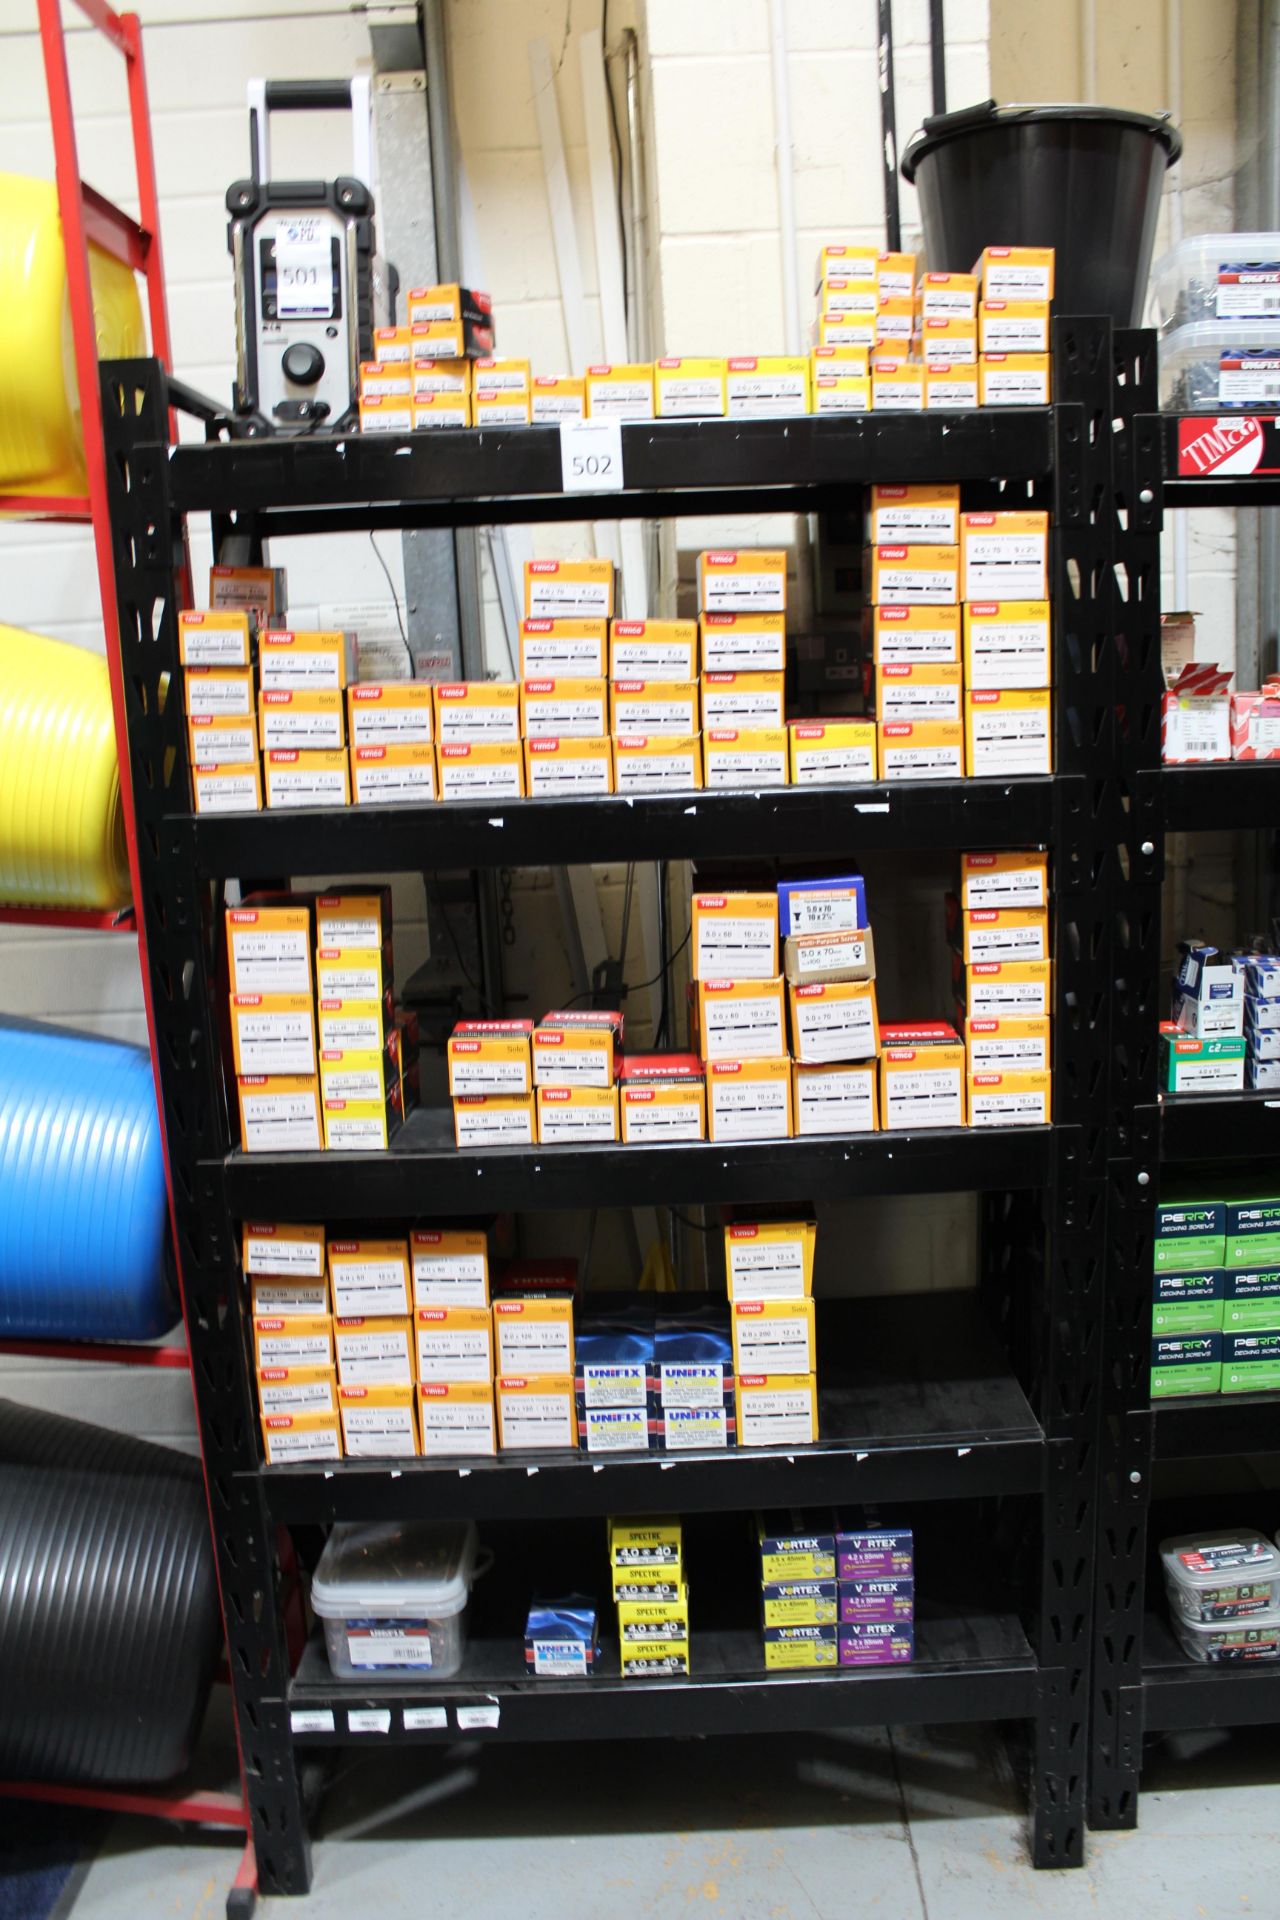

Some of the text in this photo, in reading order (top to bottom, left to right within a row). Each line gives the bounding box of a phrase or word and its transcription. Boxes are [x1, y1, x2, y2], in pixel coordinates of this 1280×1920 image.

[283, 266, 318, 286] 501
[573, 456, 612, 476] 502
[801, 950, 814, 958] 5.0
[1162, 1211, 1214, 1223] PERRY
[1238, 1208, 1280, 1220] PERR
[1162, 1224, 1187, 1232] DECKING
[1160, 1276, 1214, 1288] PERRY
[1236, 1273, 1280, 1284] PERR
[1160, 1289, 1185, 1297] DECKING
[1158, 1339, 1212, 1351] PERRY
[629, 1532, 662, 1540] SPECTRE
[777, 1539, 818, 1549] VORTEX
[655, 1547, 671, 1556] 40
[654, 1585, 670, 1593] 40
[779, 1586, 820, 1595] VORTEX
[662, 1624, 678, 1632] 40
[779, 1628, 820, 1637] VORTEX
[663, 1658, 678, 1666] 40
